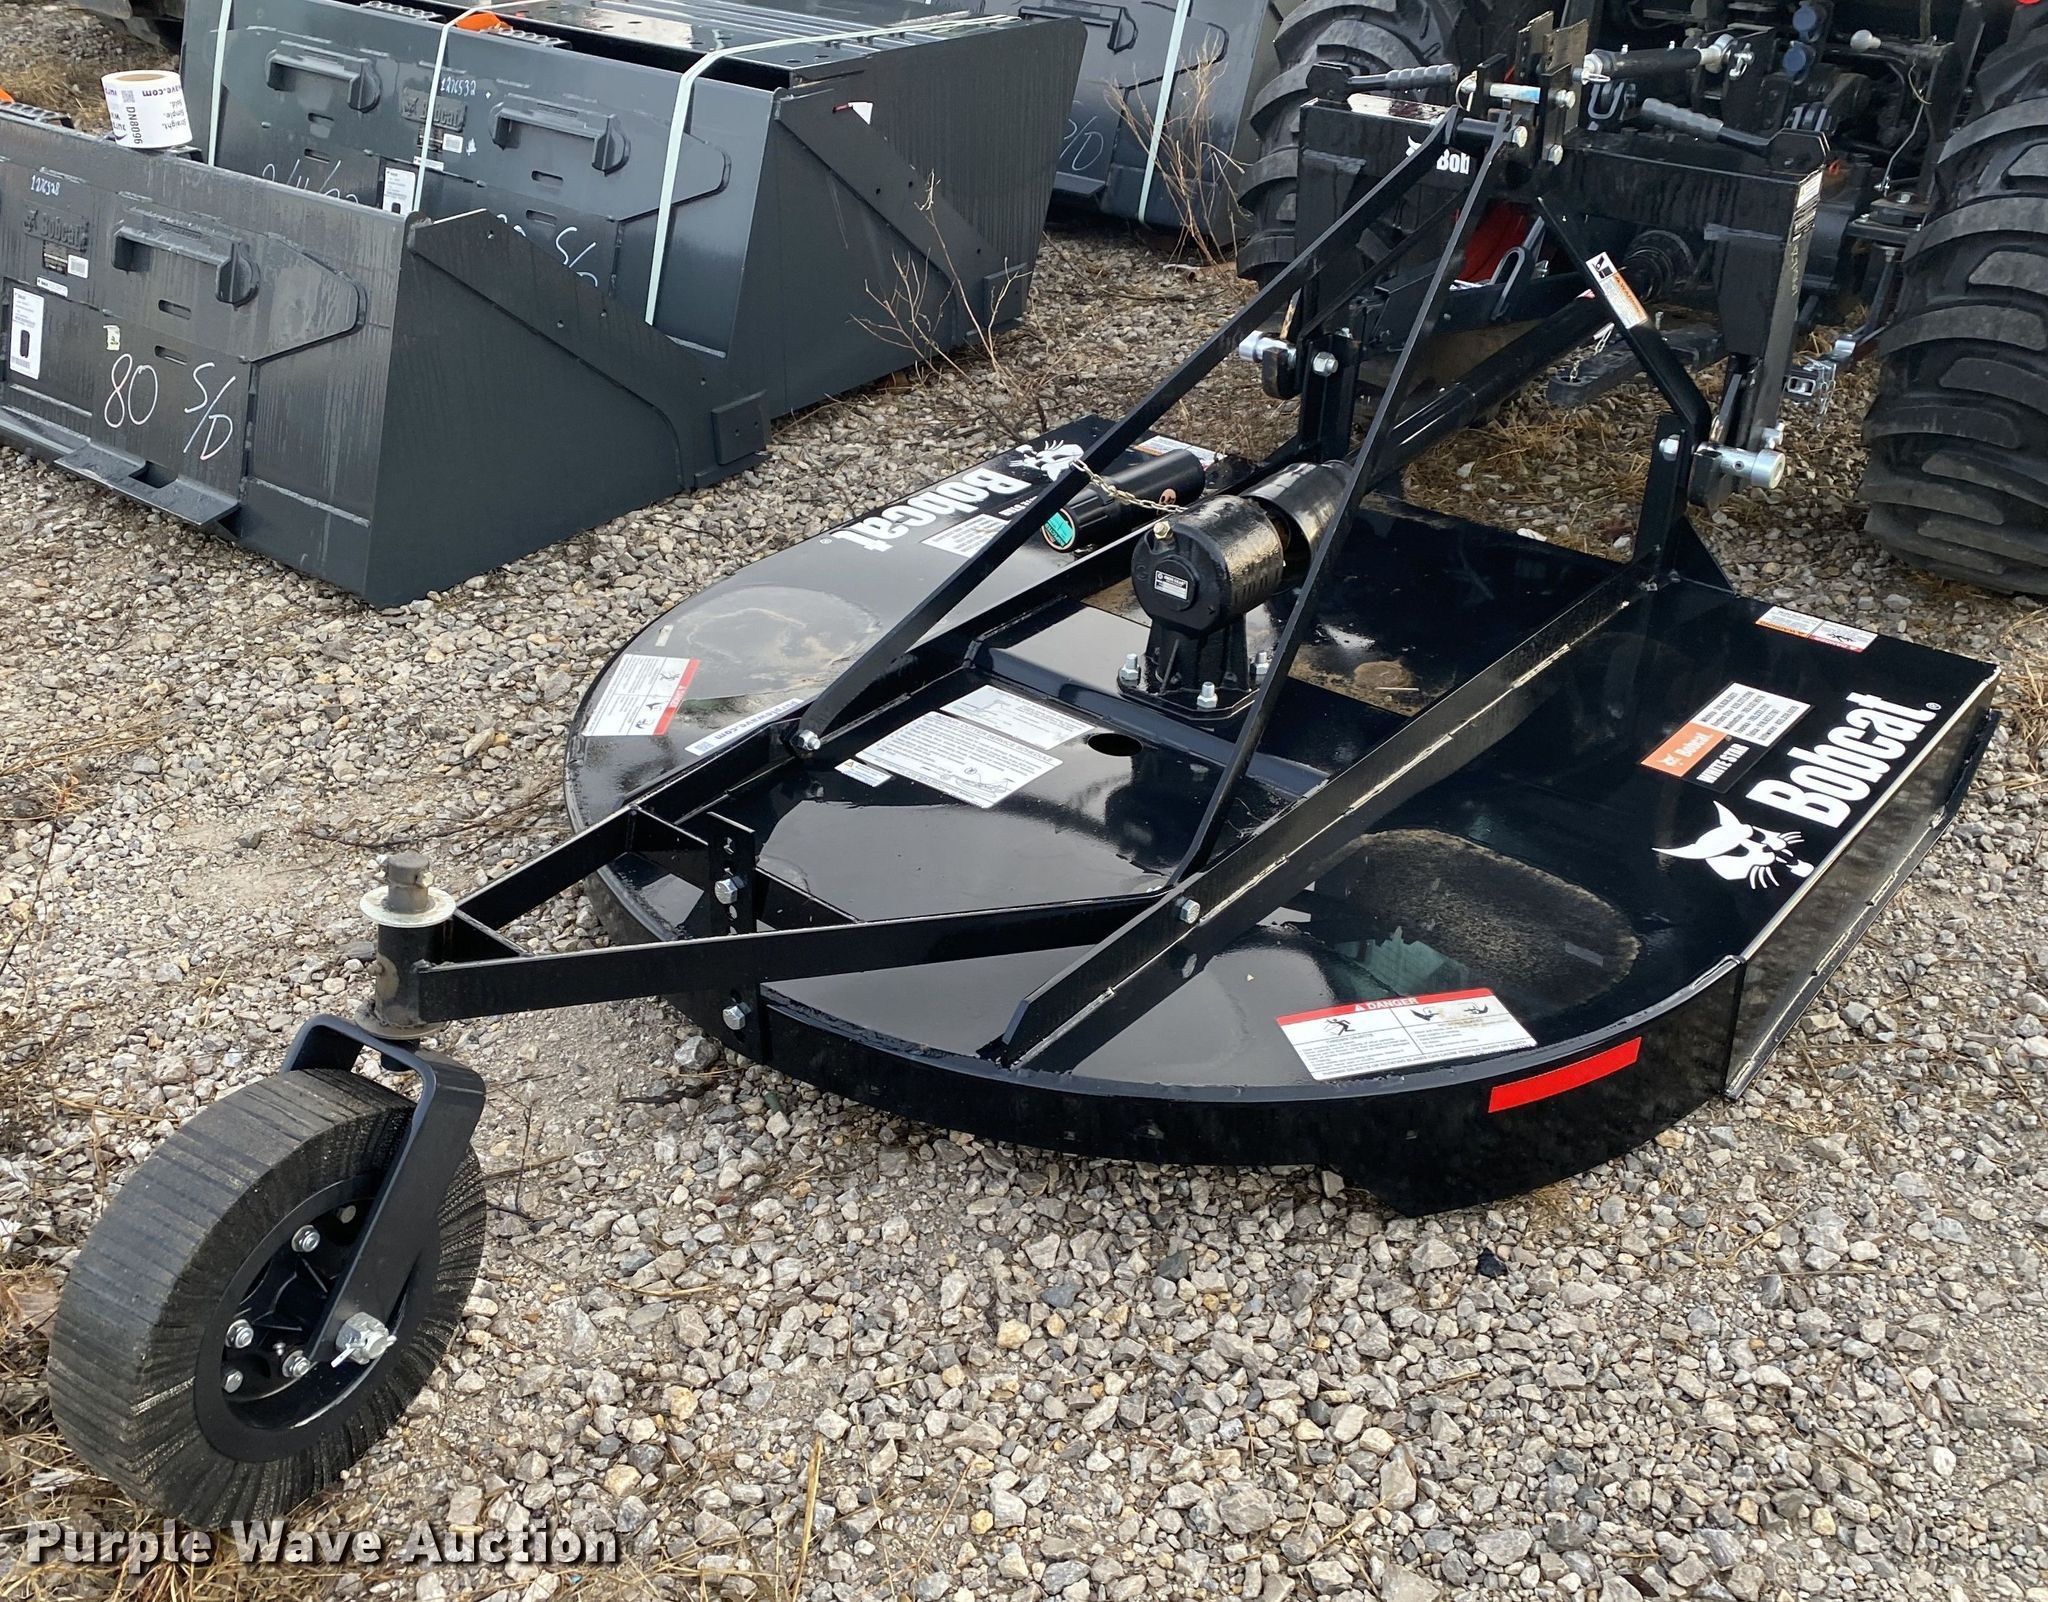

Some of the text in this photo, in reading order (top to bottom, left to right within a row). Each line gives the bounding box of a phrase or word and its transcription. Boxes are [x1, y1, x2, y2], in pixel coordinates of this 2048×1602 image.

[126, 106, 143, 145] DN8096
[104, 353, 237, 460] 80 S/D
[830, 467, 1033, 553] Bobcat
[1677, 731, 1713, 758] Bobcat
[1696, 743, 1750, 784] WHITE STAR
[1745, 692, 1937, 829] Bobcat
[1365, 997, 1420, 1011] DANGER
